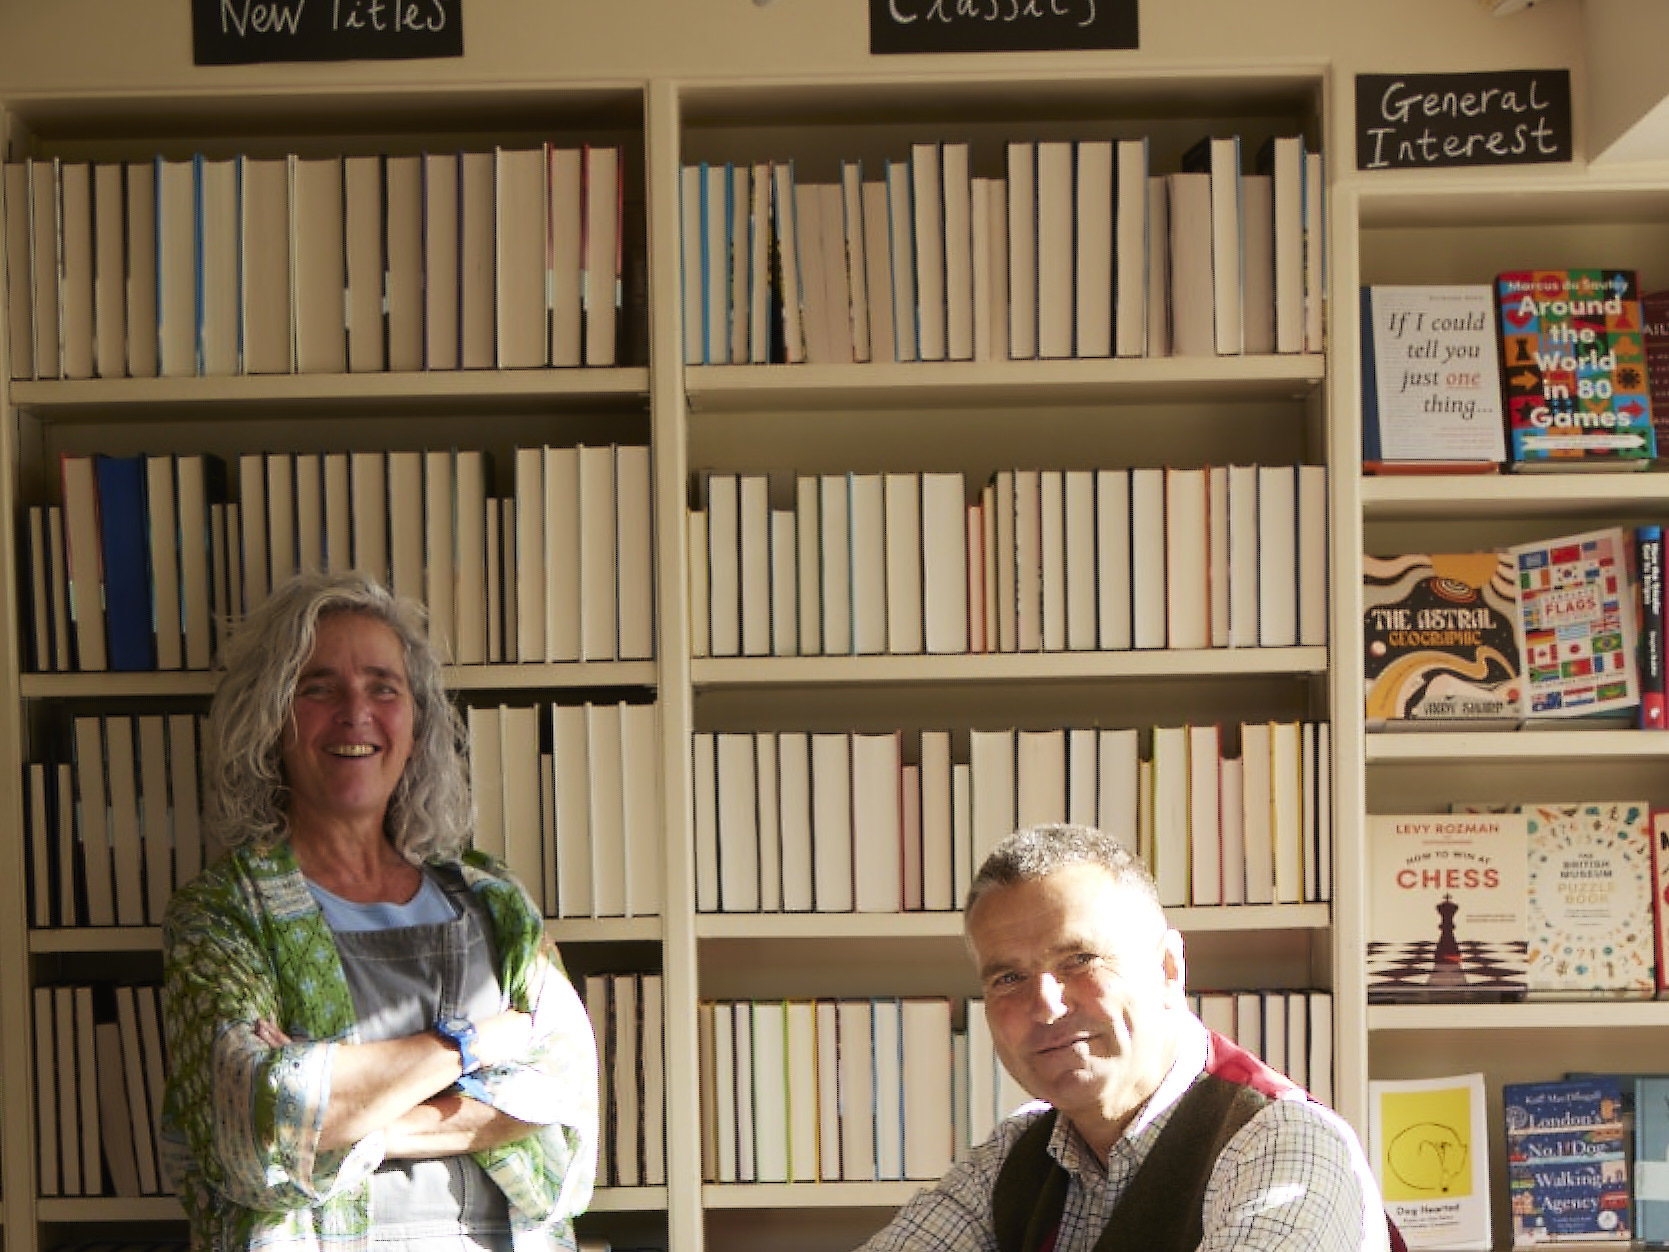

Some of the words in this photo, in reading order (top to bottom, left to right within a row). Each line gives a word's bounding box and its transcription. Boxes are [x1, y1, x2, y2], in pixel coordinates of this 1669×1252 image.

[220, 0, 305, 36] New
[332, 0, 446, 31] Titles
[1381, 80, 1549, 122] General
[1366, 116, 1558, 168] Interest
[1518, 294, 1623, 317] Around
[1389, 312, 1411, 339] If
[1432, 310, 1485, 331] could
[1549, 321, 1596, 343] the
[1407, 339, 1439, 359] tell
[1442, 344, 1480, 364] you
[1534, 348, 1618, 372] World
[1400, 370, 1439, 393] just
[1446, 371, 1481, 389] one
[1543, 378, 1570, 400] in
[1579, 378, 1612, 399] 80
[1530, 406, 1632, 428] Games
[1546, 597, 1597, 616] FLAGS
[1370, 608, 1412, 631] THE
[1416, 607, 1497, 630] ASTRAL
[1396, 823, 1430, 835] LEVY
[1435, 822, 1499, 834] ROZMAN
[1406, 852, 1431, 865] HOW
[1396, 869, 1499, 890] CHESS
[1534, 1170, 1602, 1189] Walking
[1397, 1206, 1418, 1216] Dog
[1542, 1196, 1599, 1213] Agency
